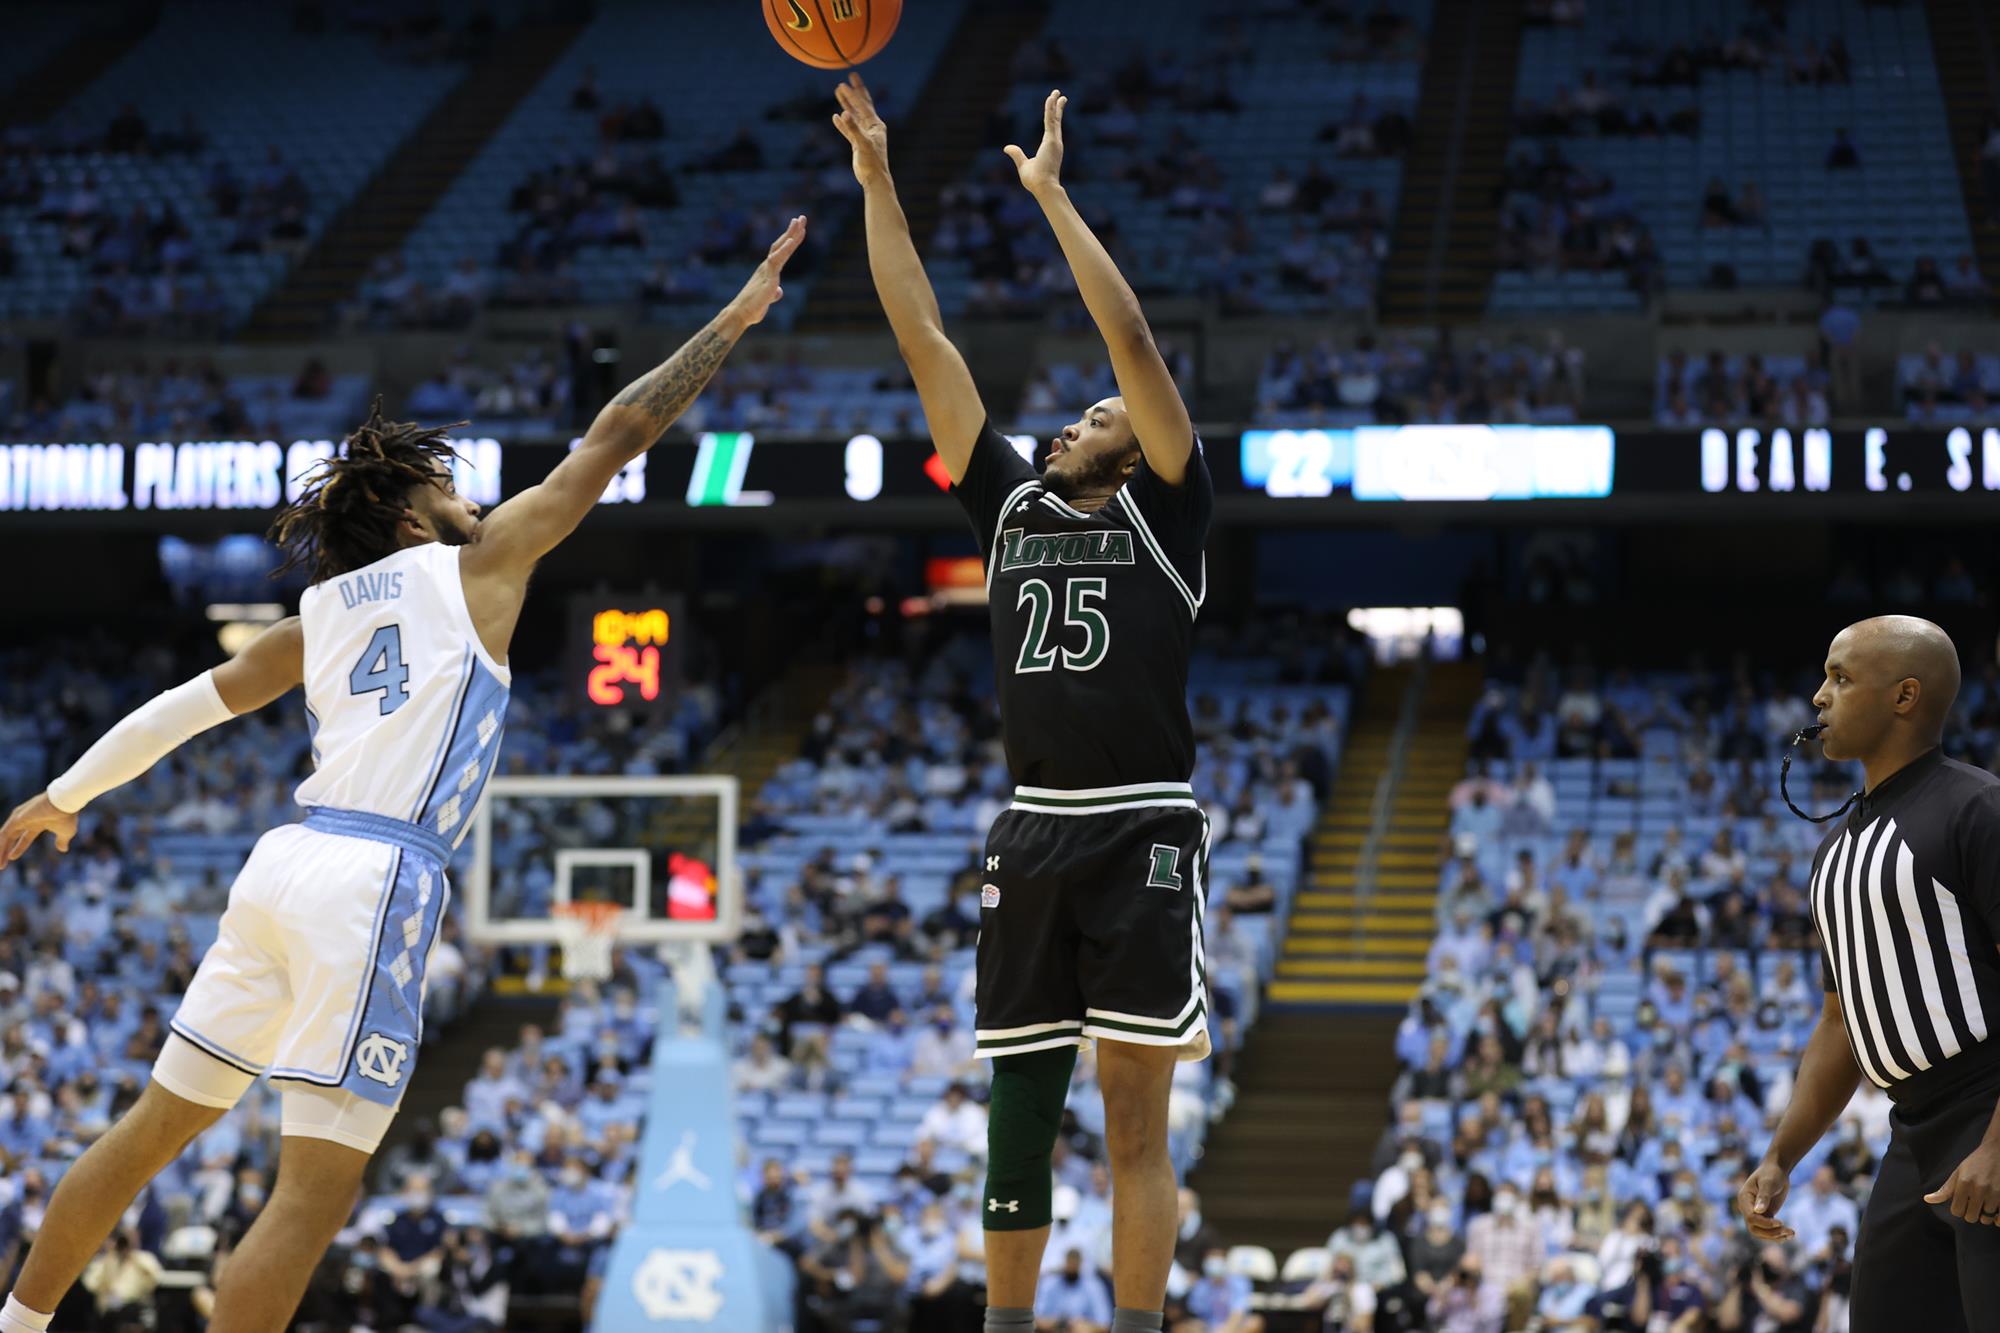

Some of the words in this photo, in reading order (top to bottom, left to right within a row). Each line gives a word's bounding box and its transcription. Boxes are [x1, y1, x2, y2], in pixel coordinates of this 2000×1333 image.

[134, 440, 283, 510] PLAYERS
[1265, 428, 1334, 498] 22
[1701, 427, 1832, 492] DEAN
[1864, 427, 1913, 492] E.
[339, 571, 403, 610] DAVIS
[1015, 577, 1110, 674] 25
[348, 623, 410, 716] 4
[587, 646, 660, 705] 24
[1146, 843, 1182, 891] L
